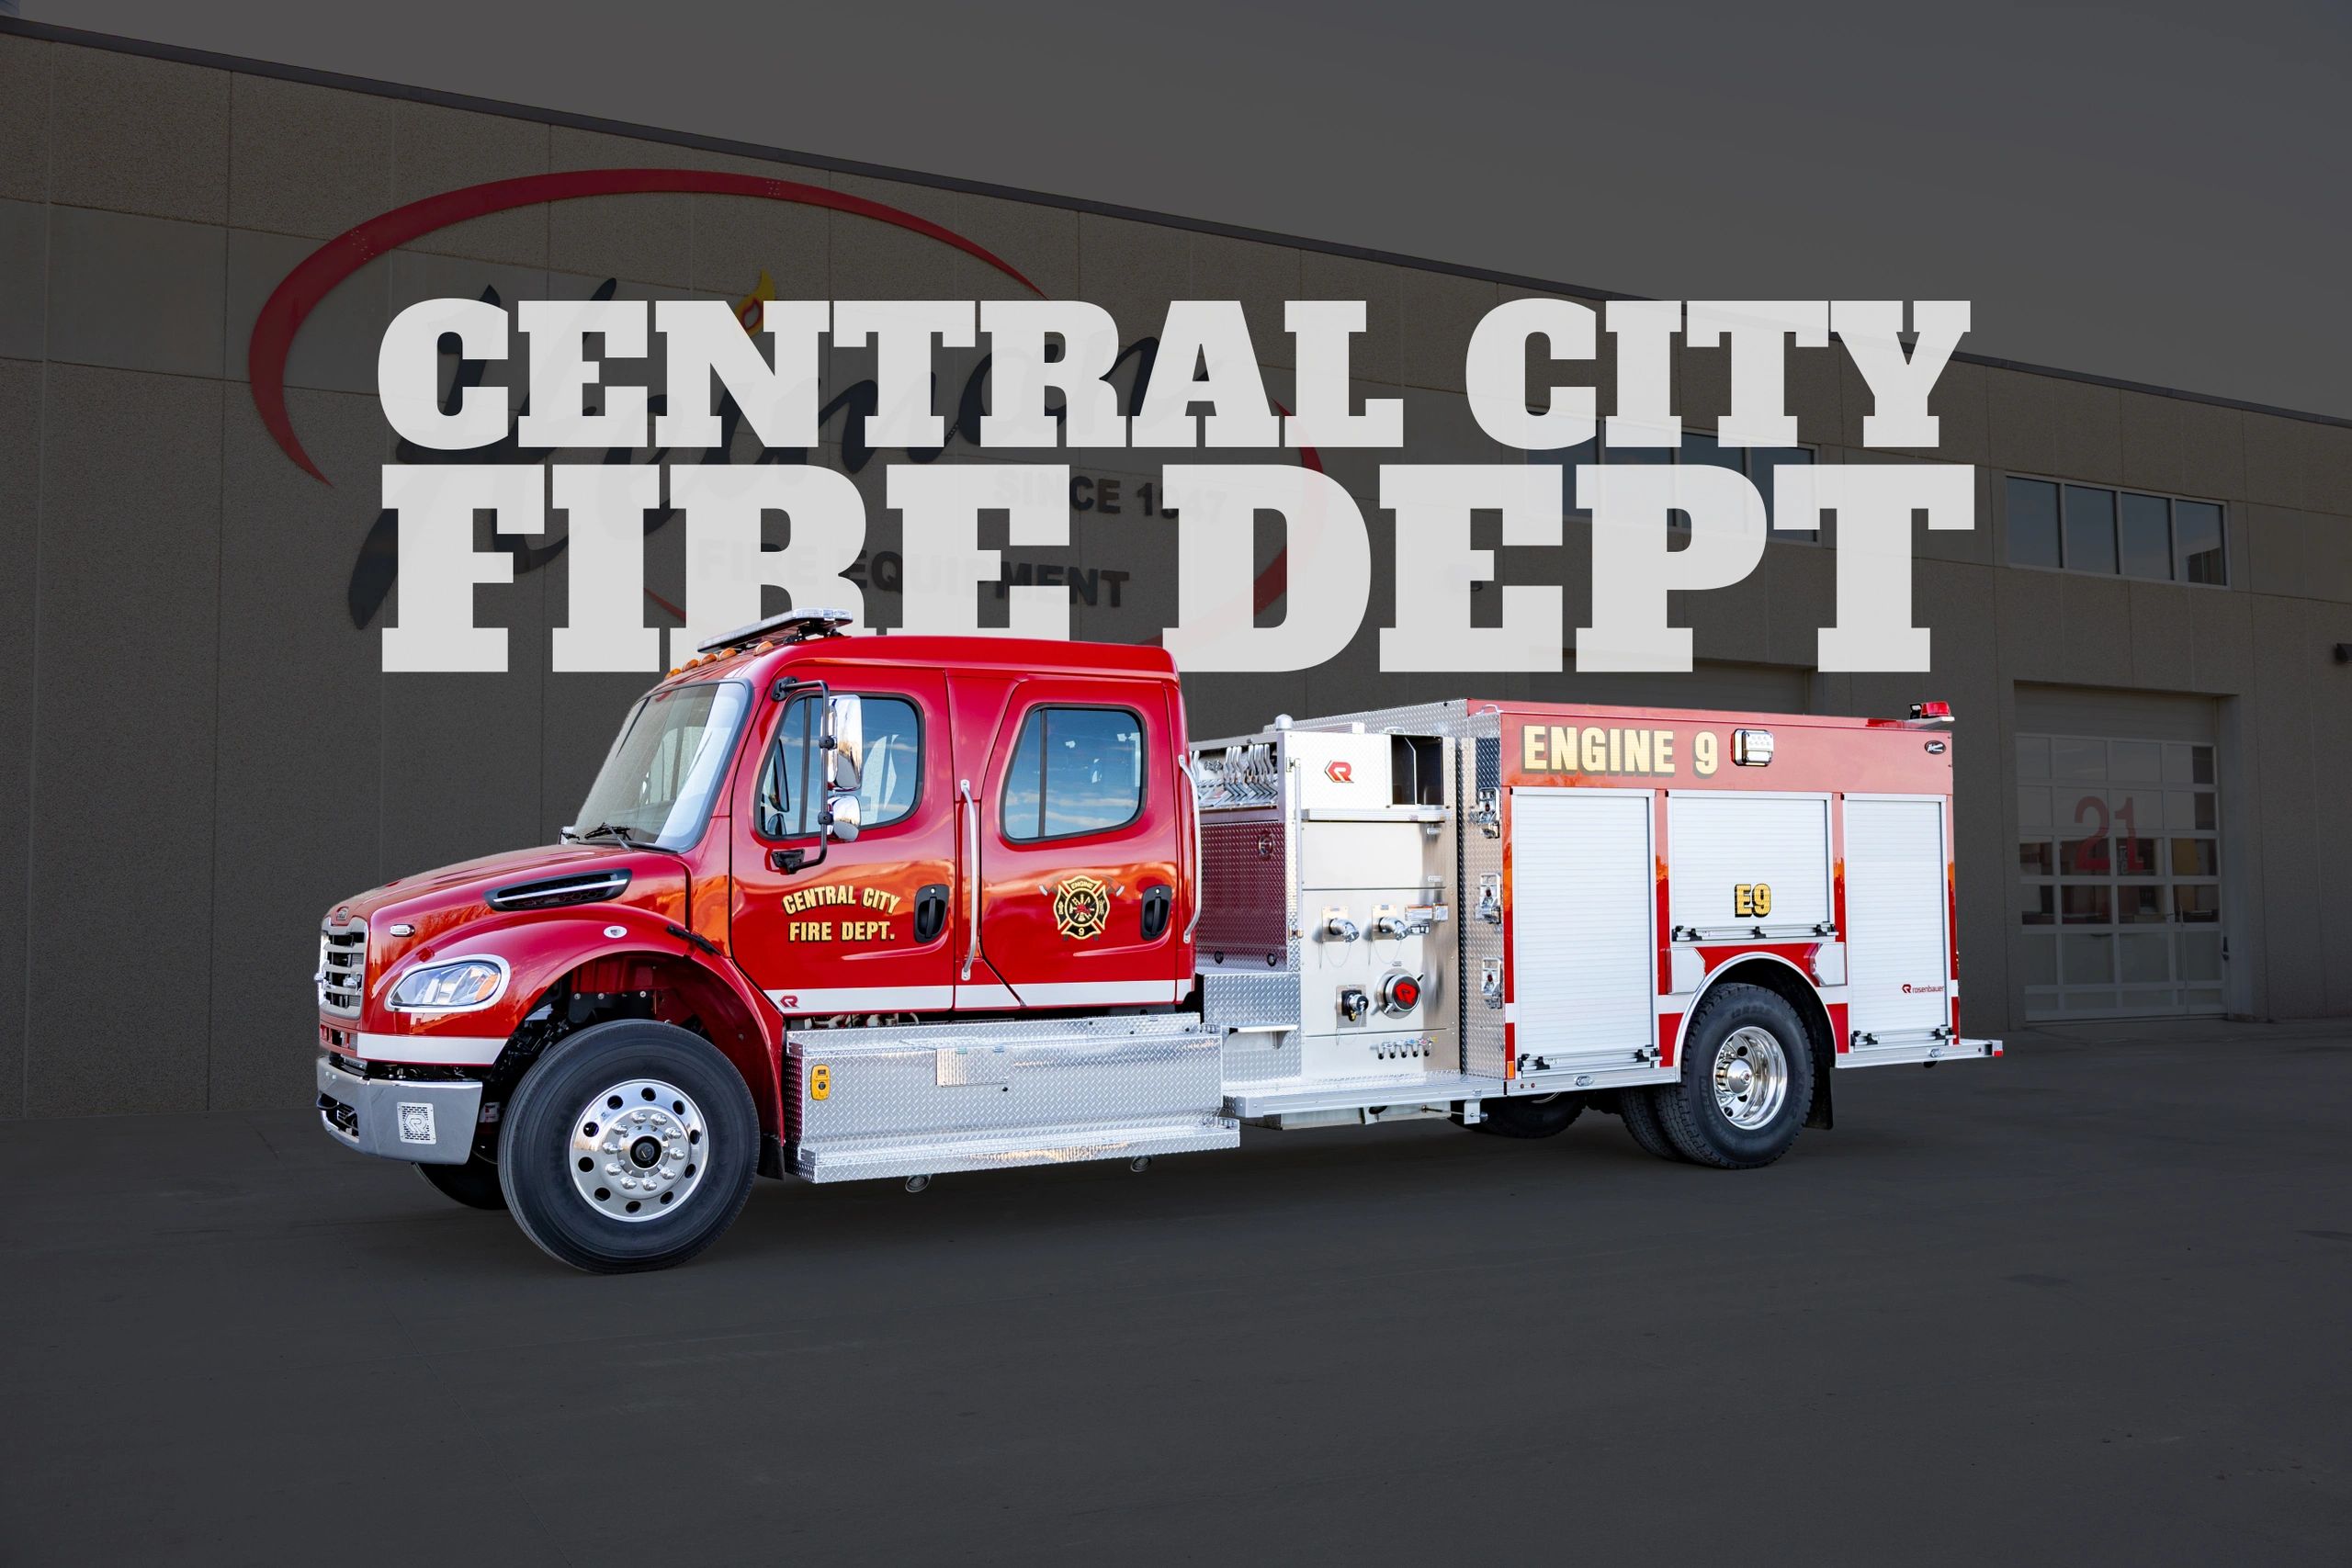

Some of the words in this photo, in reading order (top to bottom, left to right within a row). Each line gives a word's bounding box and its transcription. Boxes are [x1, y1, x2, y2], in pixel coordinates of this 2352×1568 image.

[1521, 725, 1675, 775] ENGINE
[1693, 731, 1718, 778] 9
[2075, 795, 2143, 874] 21
[782, 885, 856, 915] CENTRAL
[862, 886, 901, 914] CITY
[1070, 881, 1093, 889] ENGINE
[1735, 884, 1771, 918] E9
[788, 921, 832, 942] FIRE
[841, 920, 896, 942] DEPT.
[1078, 927, 1085, 936] 9
